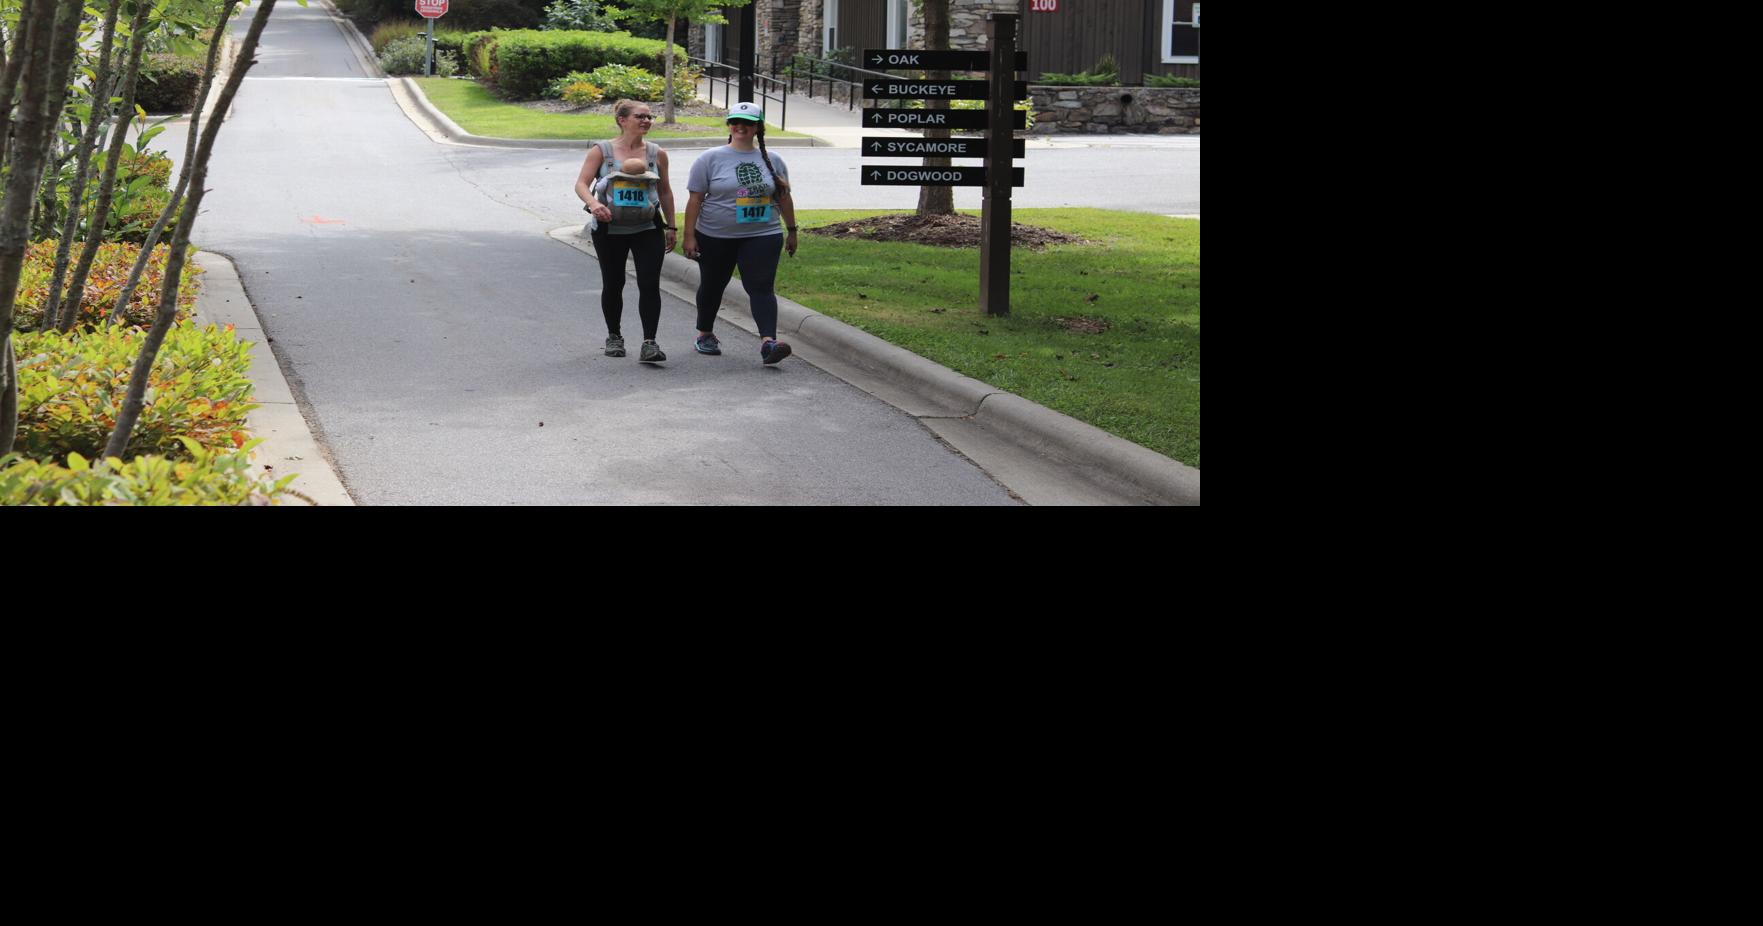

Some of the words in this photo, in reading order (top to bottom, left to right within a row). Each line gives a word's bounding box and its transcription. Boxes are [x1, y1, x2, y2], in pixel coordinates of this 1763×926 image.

[1032, 0, 1057, 10] 100
[889, 54, 919, 65] OAK
[888, 84, 956, 95] BUCKEYE
[888, 113, 945, 124] POPLAR
[887, 142, 967, 153] SYCAMORE
[887, 171, 962, 181] DOGWOOD
[617, 190, 644, 201] 1418
[742, 206, 766, 218] 1417
